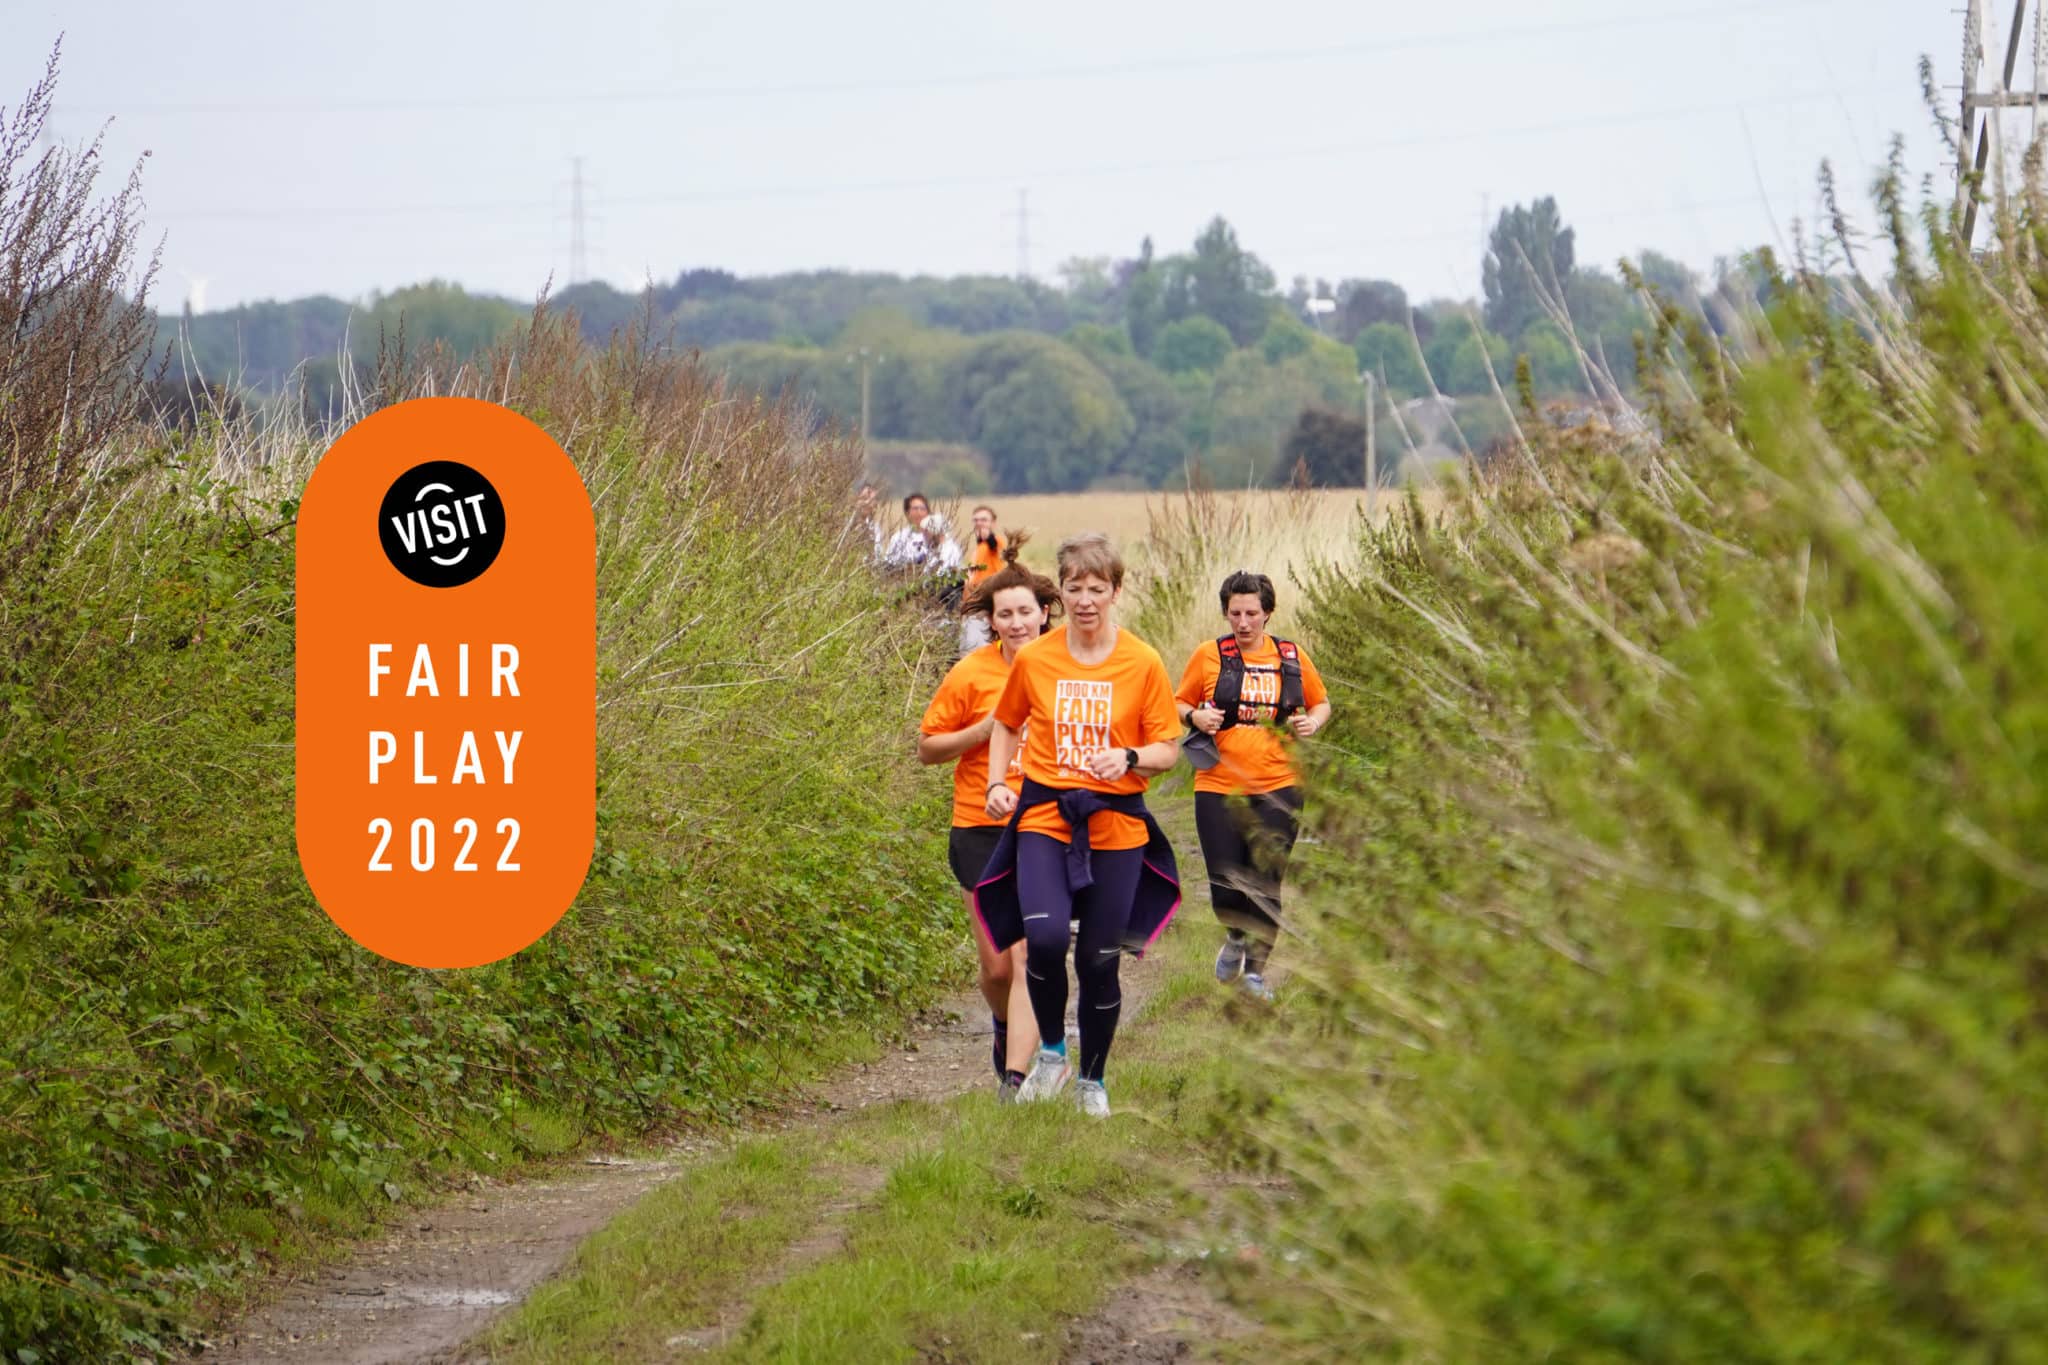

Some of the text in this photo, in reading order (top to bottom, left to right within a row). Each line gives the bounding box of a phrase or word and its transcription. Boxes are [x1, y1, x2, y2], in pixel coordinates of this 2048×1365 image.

[1059, 682, 1110, 698] 1000 KM
[1057, 697, 1109, 724] FAIR
[1057, 723, 1108, 746] PLAY
